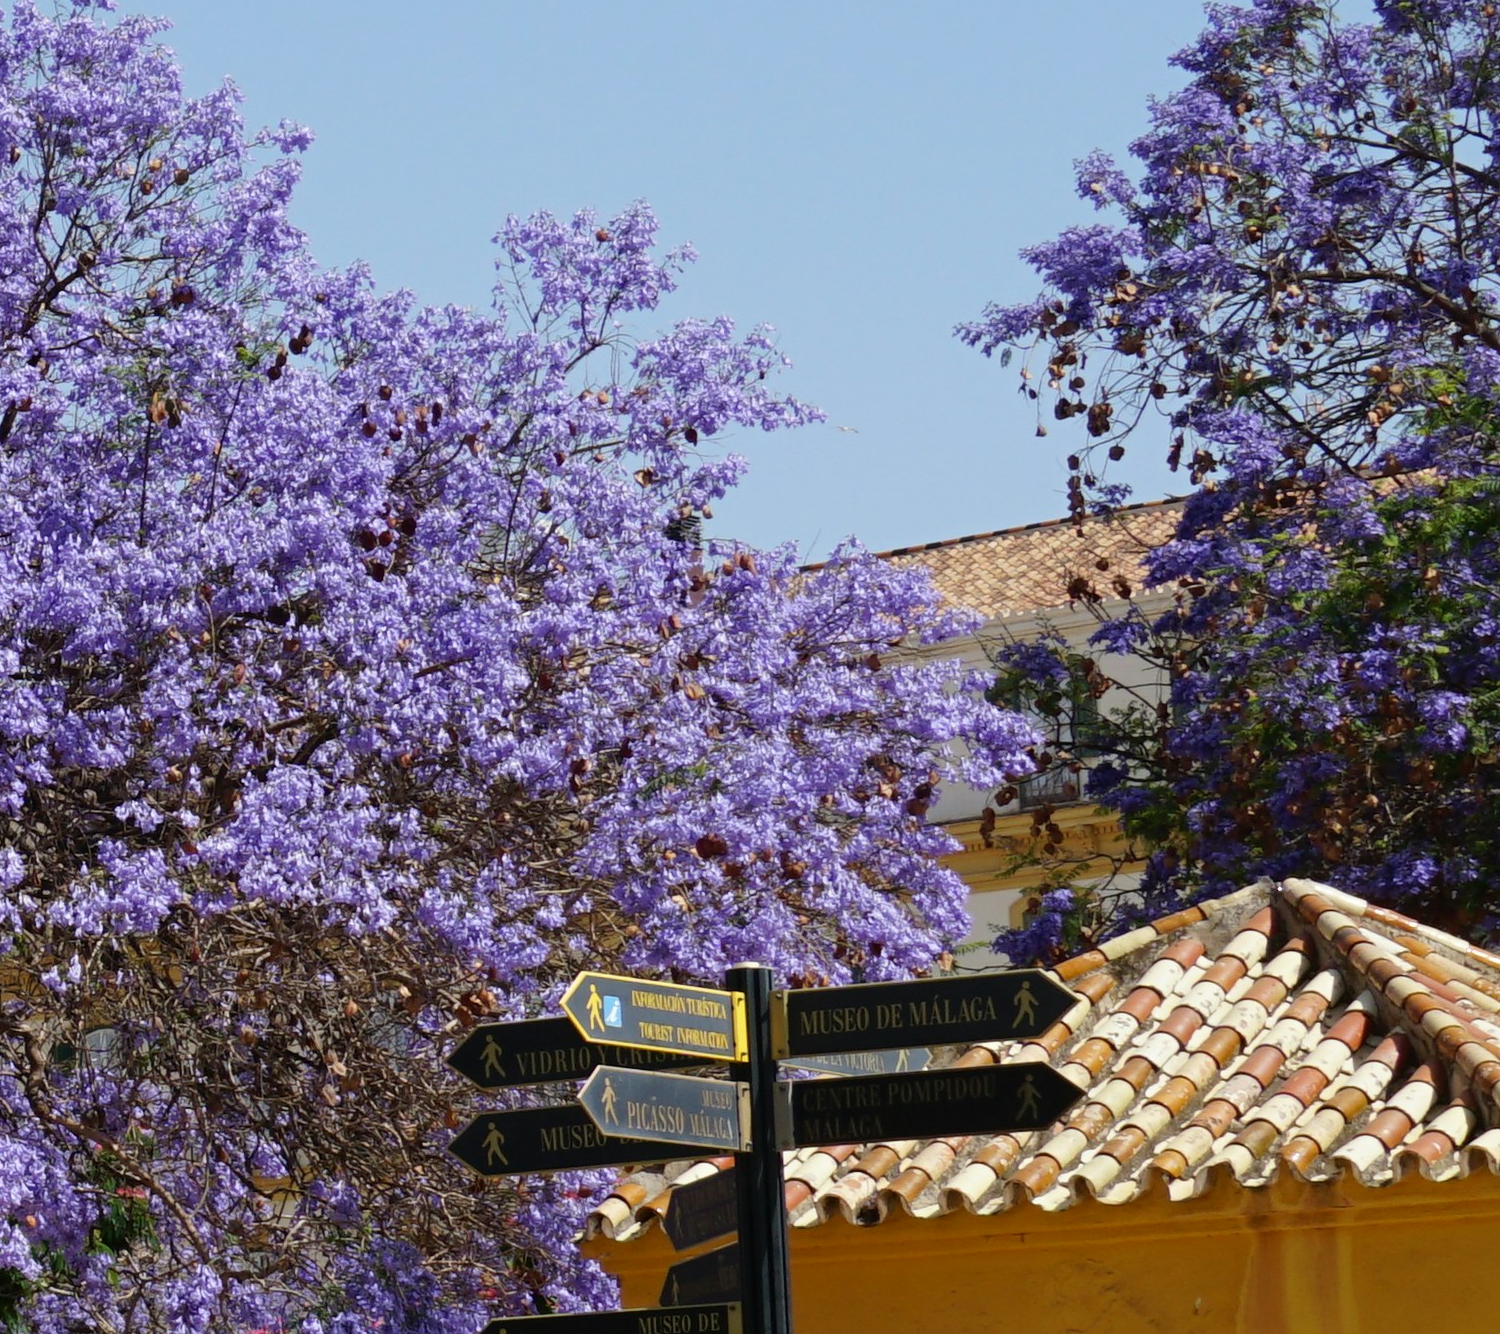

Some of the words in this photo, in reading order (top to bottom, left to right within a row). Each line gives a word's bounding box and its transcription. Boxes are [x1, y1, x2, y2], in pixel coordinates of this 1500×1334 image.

[632, 990, 686, 1014] INFORMACIÓN
[687, 996, 727, 1019] TURÍSTICA
[800, 1007, 870, 1035] MUSEO
[876, 1004, 903, 1030] DE
[909, 994, 997, 1026] MÁLAGA
[639, 1022, 673, 1042] TOURIST
[677, 1026, 729, 1049] INFORMATION
[515, 1046, 591, 1076] VIDRIO
[701, 1089, 732, 1110] MUSEO
[803, 1082, 881, 1111] CENTRE
[888, 1073, 998, 1106] POMPIDOU
[540, 1123, 607, 1152] MUSEO
[689, 1110, 733, 1140] MÁLAGA
[803, 1113, 884, 1143] MÁLAGA
[699, 1312, 720, 1332] DE
